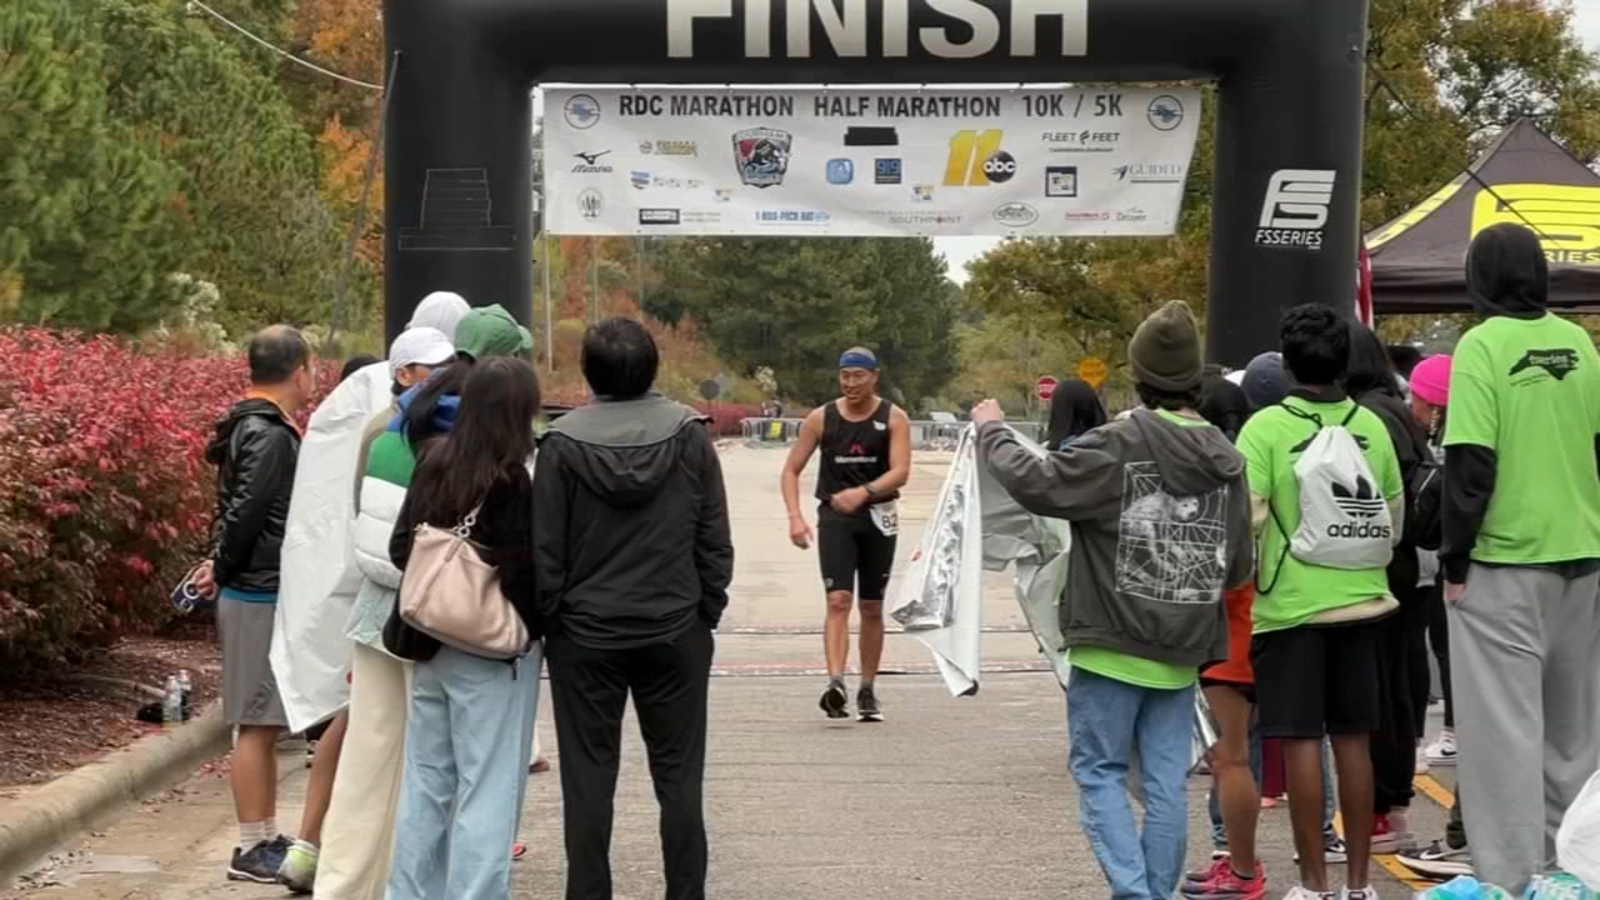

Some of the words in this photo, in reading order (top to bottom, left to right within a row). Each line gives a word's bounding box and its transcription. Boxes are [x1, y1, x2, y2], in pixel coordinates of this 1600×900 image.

[667, 0, 1088, 58] FINISH
[619, 95, 664, 116] RDC
[670, 95, 794, 116] MARATHON
[814, 95, 870, 116] HALF
[877, 95, 1001, 117] MARATHON
[1022, 94, 1064, 117] 10K
[1094, 94, 1123, 117] 5K
[1042, 132, 1077, 142] FLEET
[1092, 132, 1121, 142] FEET
[983, 157, 1016, 173] abc
[1254, 229, 1324, 246] FSSERIES
[1327, 523, 1391, 539] adidas
